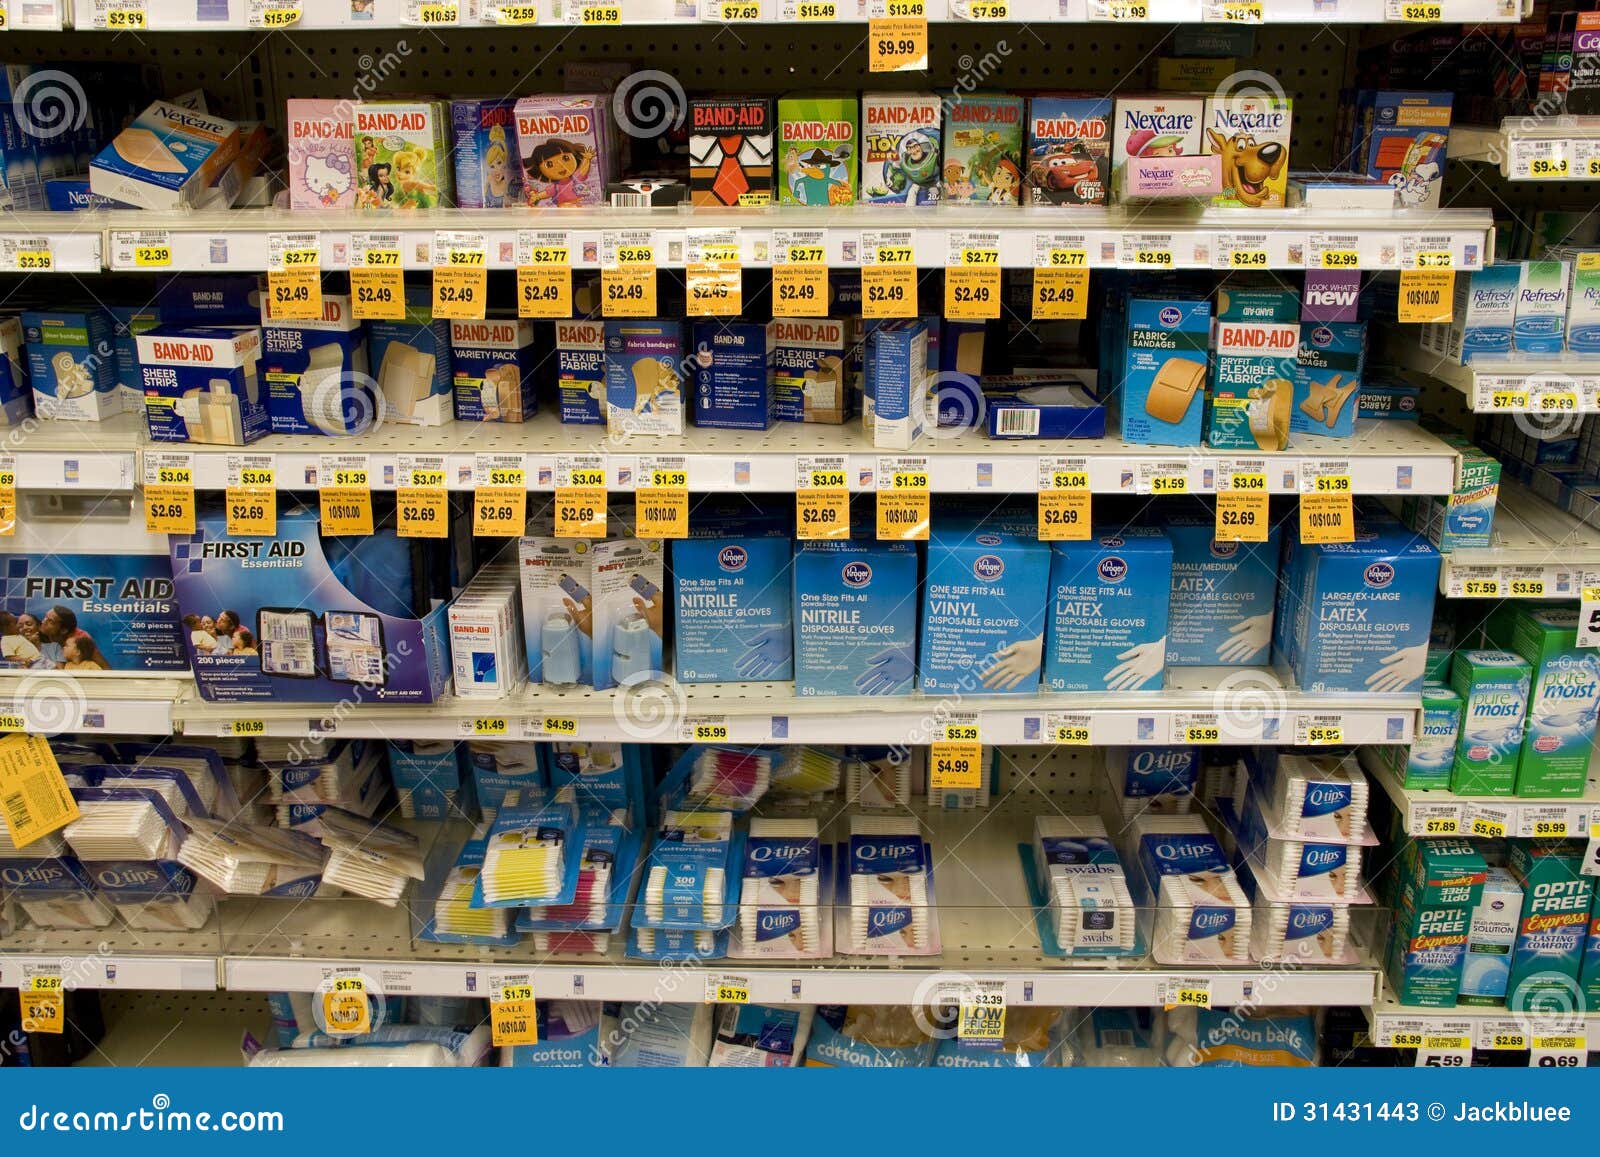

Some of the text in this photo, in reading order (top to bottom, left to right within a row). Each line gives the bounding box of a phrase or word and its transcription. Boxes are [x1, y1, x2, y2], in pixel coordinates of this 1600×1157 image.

[889, 5, 923, 16] $13.49
[1406, 7, 1441, 19] $24.99
[878, 40, 915, 55] $9.99
[152, 105, 226, 135] Nexcare
[357, 113, 426, 131] BAND-AID
[694, 107, 765, 127] BAND-AID
[867, 107, 935, 124] BAND-AID
[1215, 110, 1283, 133] Nexcare
[519, 114, 590, 136] BAND-AID
[1036, 119, 1106, 139] BAND-AID
[1125, 111, 1193, 134] Nexcare
[783, 121, 852, 141] BAND-AID
[867, 134, 902, 151] TOY
[868, 151, 899, 161] STORY
[20, 256, 50, 268] $2.39
[139, 250, 169, 261] $2.39
[286, 252, 317, 264] $2.77
[451, 253, 483, 265] $2.77
[790, 250, 823, 262] $2.77
[966, 252, 998, 264] $2.77
[1052, 253, 1084, 265] $2.77
[1234, 253, 1266, 264] $2.49
[1325, 254, 1358, 265] $2.99
[276, 287, 309, 302] $2.49
[524, 285, 558, 301] $2.49
[608, 284, 643, 300] $2.49
[779, 284, 814, 300] $2.49
[869, 286, 903, 301] $2.49
[954, 287, 989, 302] $2.49
[1330, 284, 1359, 292] WHAT'S
[358, 287, 392, 303] $2.49
[439, 287, 473, 303] $2.49
[1039, 287, 1074, 303] $2.49
[1305, 291, 1357, 306] new
[1520, 288, 1565, 302] Refresh
[453, 324, 515, 342] BAND-AID
[775, 323, 840, 342] BAND-AID
[1133, 331, 1168, 341] FABRIC
[1222, 328, 1296, 349] BAND-AID
[266, 339, 303, 350] STRIPS
[627, 340, 676, 350] fabric bandages
[1132, 339, 1176, 349] BANDAGES
[153, 342, 214, 362] BAND-AID
[455, 350, 517, 360] VARIETY PACK
[776, 350, 825, 361] FLEXIBLE
[560, 361, 599, 371] FABRIC
[775, 358, 814, 369] FABRIC
[1220, 364, 1275, 375] FLEXIBLE
[143, 368, 176, 379] SHEER
[1219, 373, 1262, 384] FABRIC
[144, 377, 178, 388] STRIPS
[160, 472, 189, 483] $3.04
[242, 473, 271, 484] $3.04
[336, 473, 366, 484] $1.39
[572, 473, 602, 485] $3.04
[654, 474, 685, 486] $1.39
[813, 474, 843, 486] $3.04
[895, 476, 926, 487] $1.39
[1055, 476, 1085, 487] $3.04
[1154, 478, 1184, 490] $1.59
[1233, 477, 1264, 489] $3.04
[151, 504, 182, 519] $2.69
[232, 505, 264, 520] $2.69
[328, 506, 360, 519] 10/$10.00
[403, 507, 435, 521] $2.69
[480, 506, 512, 521] $2.69
[561, 507, 594, 521] $2.69
[803, 508, 836, 523] $2.69
[1044, 510, 1078, 524] $2.69
[1222, 511, 1255, 526] $2.69
[1308, 512, 1341, 527] 10/$10.00
[202, 541, 305, 559] FIRST AID
[241, 558, 304, 569] Essentials
[721, 549, 747, 566] Kroger
[679, 578, 744, 586] One Size Fits All
[1171, 578, 1215, 592] LATEX
[1513, 583, 1543, 594] $3.59
[25, 578, 174, 600] FIRST AID
[82, 601, 171, 614] Essentials
[680, 594, 737, 608] NITRILE
[680, 608, 772, 617] DISPOSABLE GLOVES
[930, 601, 978, 617] VINYL
[1056, 602, 1103, 617] LATEX
[1320, 608, 1367, 622] LATEX
[801, 610, 860, 624] NITRILE
[131, 622, 173, 631] 200 pieces
[454, 625, 490, 634] BAND-AID
[801, 625, 895, 634] DISPOSABLE GLOVES
[1319, 623, 1410, 632] DISPOSABLE GLOVES
[1543, 682, 1597, 699] moist
[1473, 691, 1511, 711] pure
[1474, 702, 1519, 717] moist
[236, 721, 264, 733] $10.99
[546, 718, 574, 731] $4.99
[1059, 729, 1088, 741] $5.99
[1189, 728, 1218, 741] $5.99
[937, 759, 969, 774] $4.99
[1133, 751, 1192, 775] Q-tips
[1310, 789, 1346, 806] Q-tips
[1427, 822, 1456, 832] $7.89
[1537, 823, 1565, 834] $9.99
[751, 846, 811, 861] Q-tips
[98, 867, 159, 888] Q-tips
[1531, 895, 1587, 912] FREE
[873, 910, 906, 928] Q-tips
[1420, 909, 1467, 923] OPTI-
[1418, 921, 1465, 934] FREE
[1414, 934, 1466, 950] Express
[1527, 941, 1575, 950] COMFORT
[1533, 935, 1574, 943] LASTING
[336, 980, 362, 991] $1.79
[720, 990, 747, 1000] $3.79
[975, 994, 1003, 1005] $2.39
[1180, 992, 1208, 1003] $4.59
[498, 1005, 525, 1013] SALE
[964, 1007, 1003, 1020] LOW
[964, 1019, 1002, 1030] PRICED
[1266, 1027, 1302, 1048] balls
[1395, 1035, 1422, 1045] $6.99
[532, 1049, 582, 1062] cotton
[817, 1044, 870, 1065] cotton
